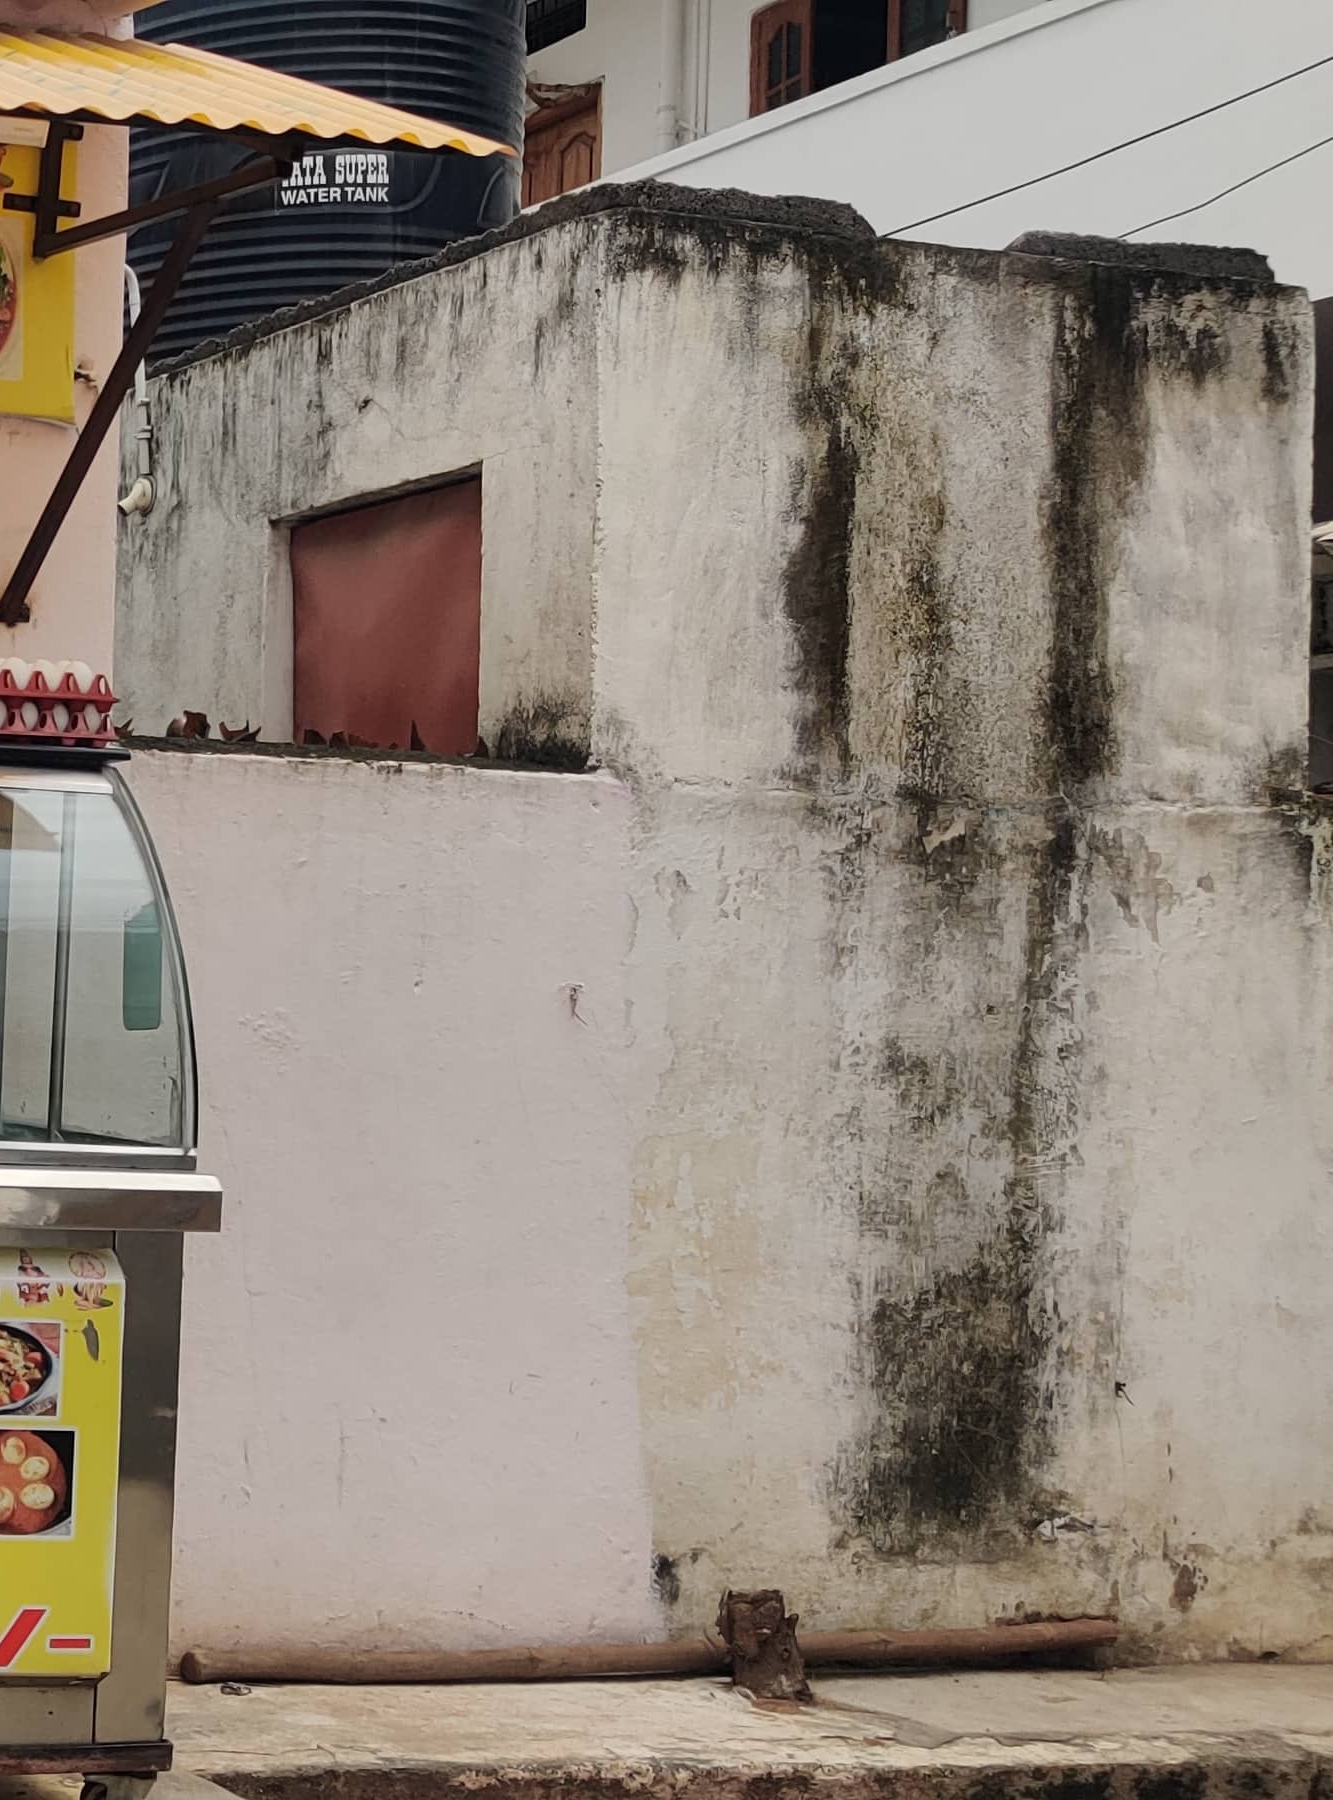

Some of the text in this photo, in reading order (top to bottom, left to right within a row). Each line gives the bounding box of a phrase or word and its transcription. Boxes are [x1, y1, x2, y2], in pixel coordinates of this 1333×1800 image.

[281, 154, 389, 187] ATA SUPER
[281, 187, 389, 205] WATER TANK
